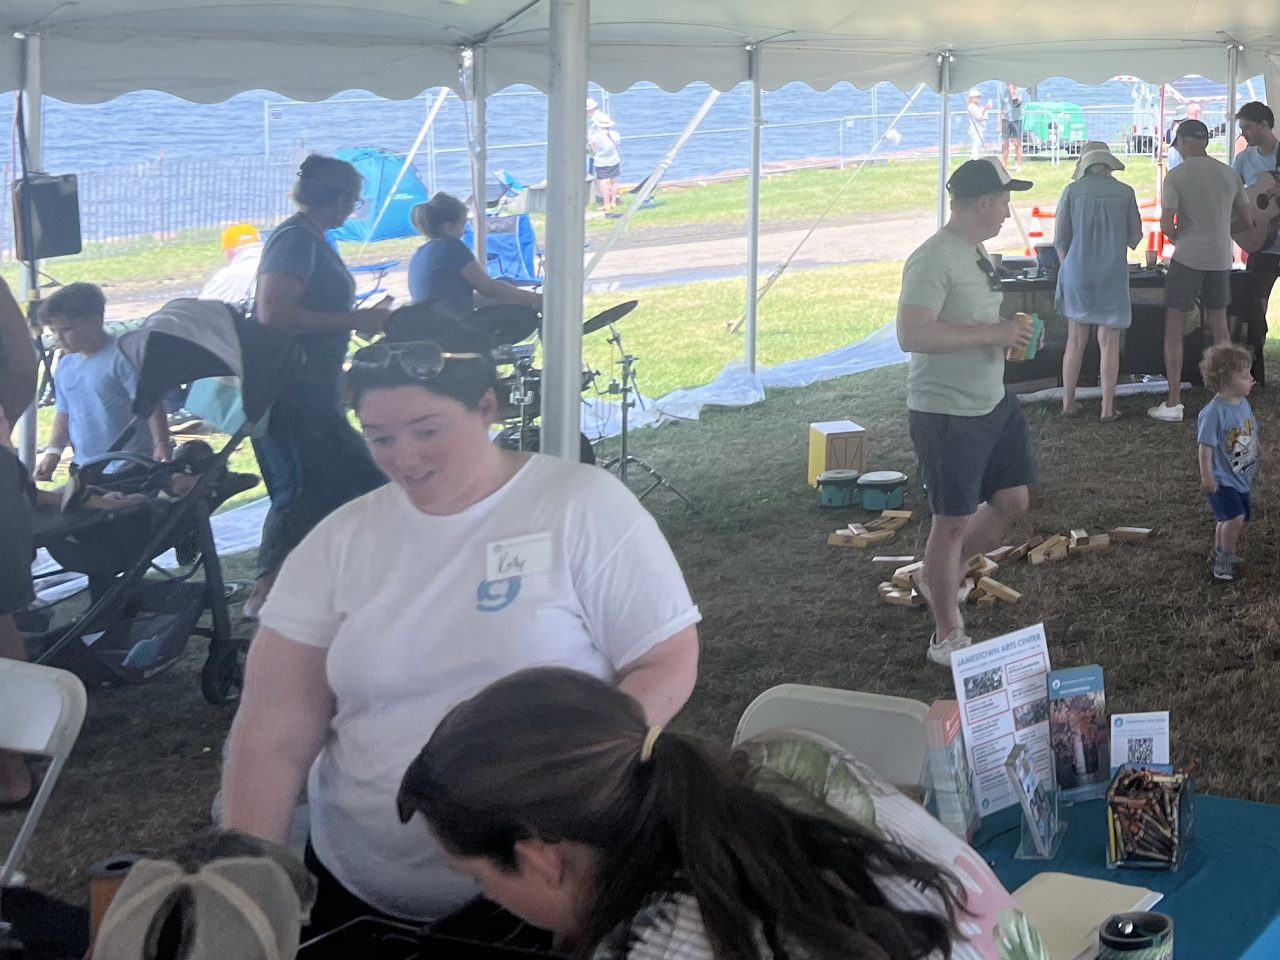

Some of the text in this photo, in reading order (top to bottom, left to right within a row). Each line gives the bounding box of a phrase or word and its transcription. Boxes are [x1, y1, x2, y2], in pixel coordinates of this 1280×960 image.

[957, 647, 1001, 667] JAMESTOWN
[1001, 640, 1018, 653] ARTS
[1017, 633, 1042, 648] CENTER
